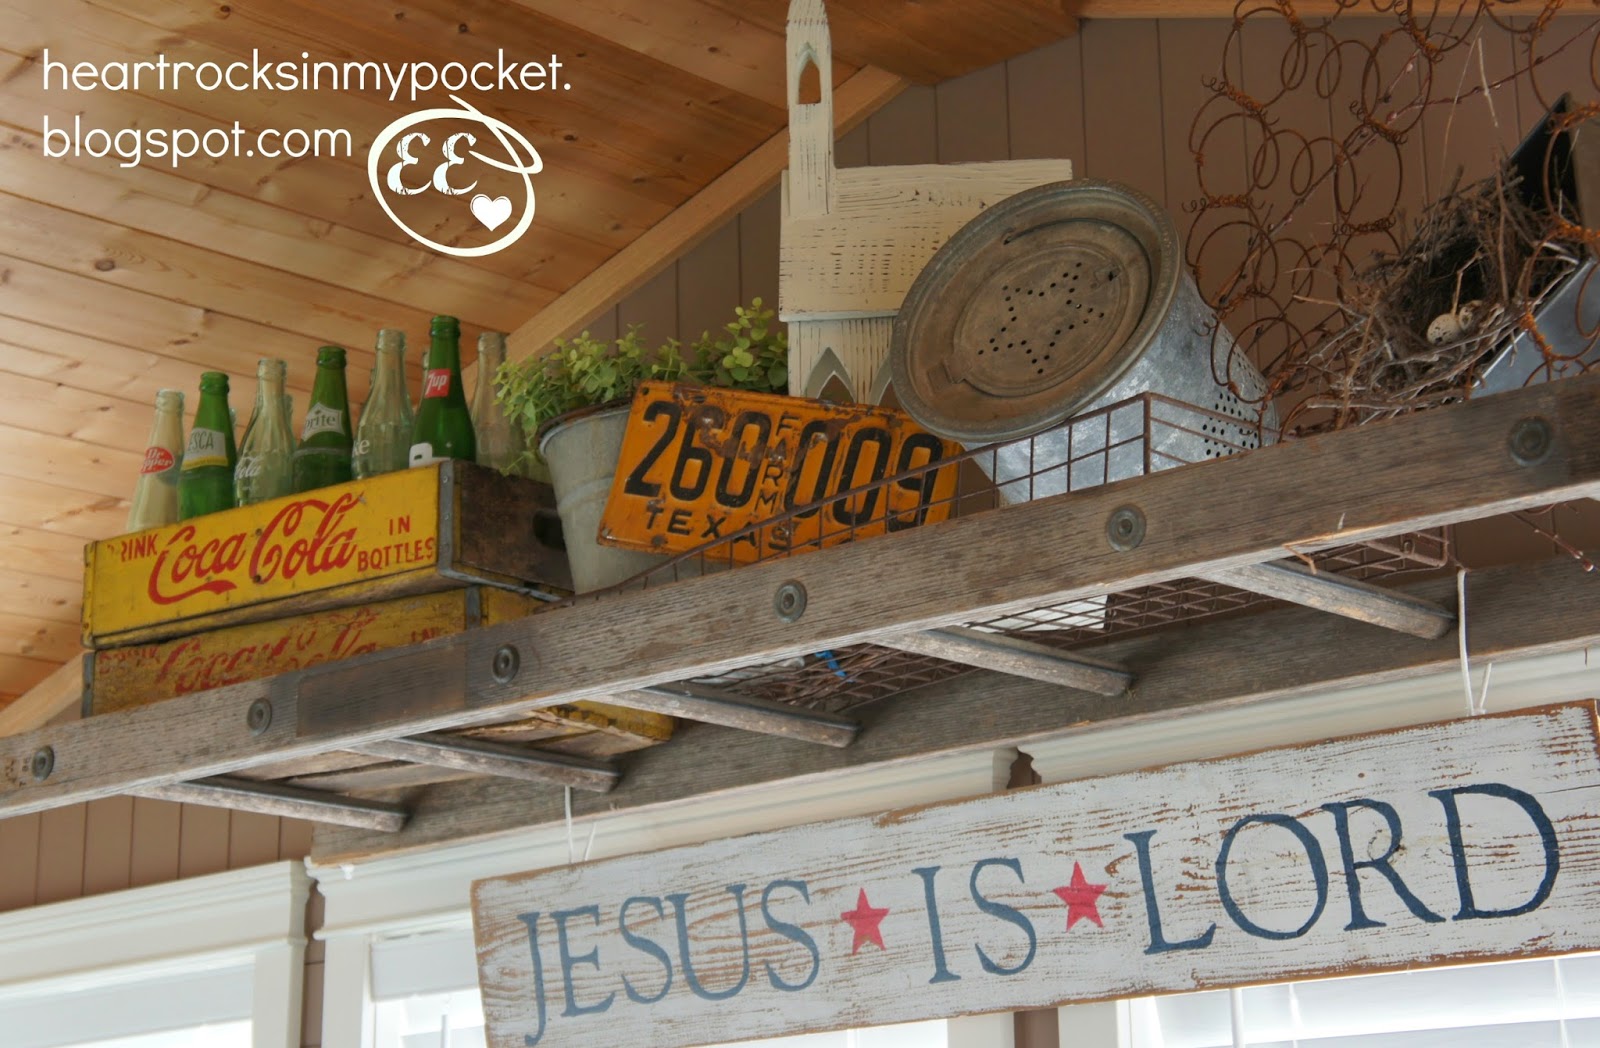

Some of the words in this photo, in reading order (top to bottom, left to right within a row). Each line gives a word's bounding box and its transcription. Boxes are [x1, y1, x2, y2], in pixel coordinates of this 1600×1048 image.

[623, 402, 773, 508] 260
[783, 420, 944, 532] 009
[357, 536, 435, 573] BOTTLES
[388, 514, 411, 536] IN
[517, 879, 820, 1047] JESUS
[911, 857, 1038, 984] IS
[1122, 782, 1561, 955] LORD
